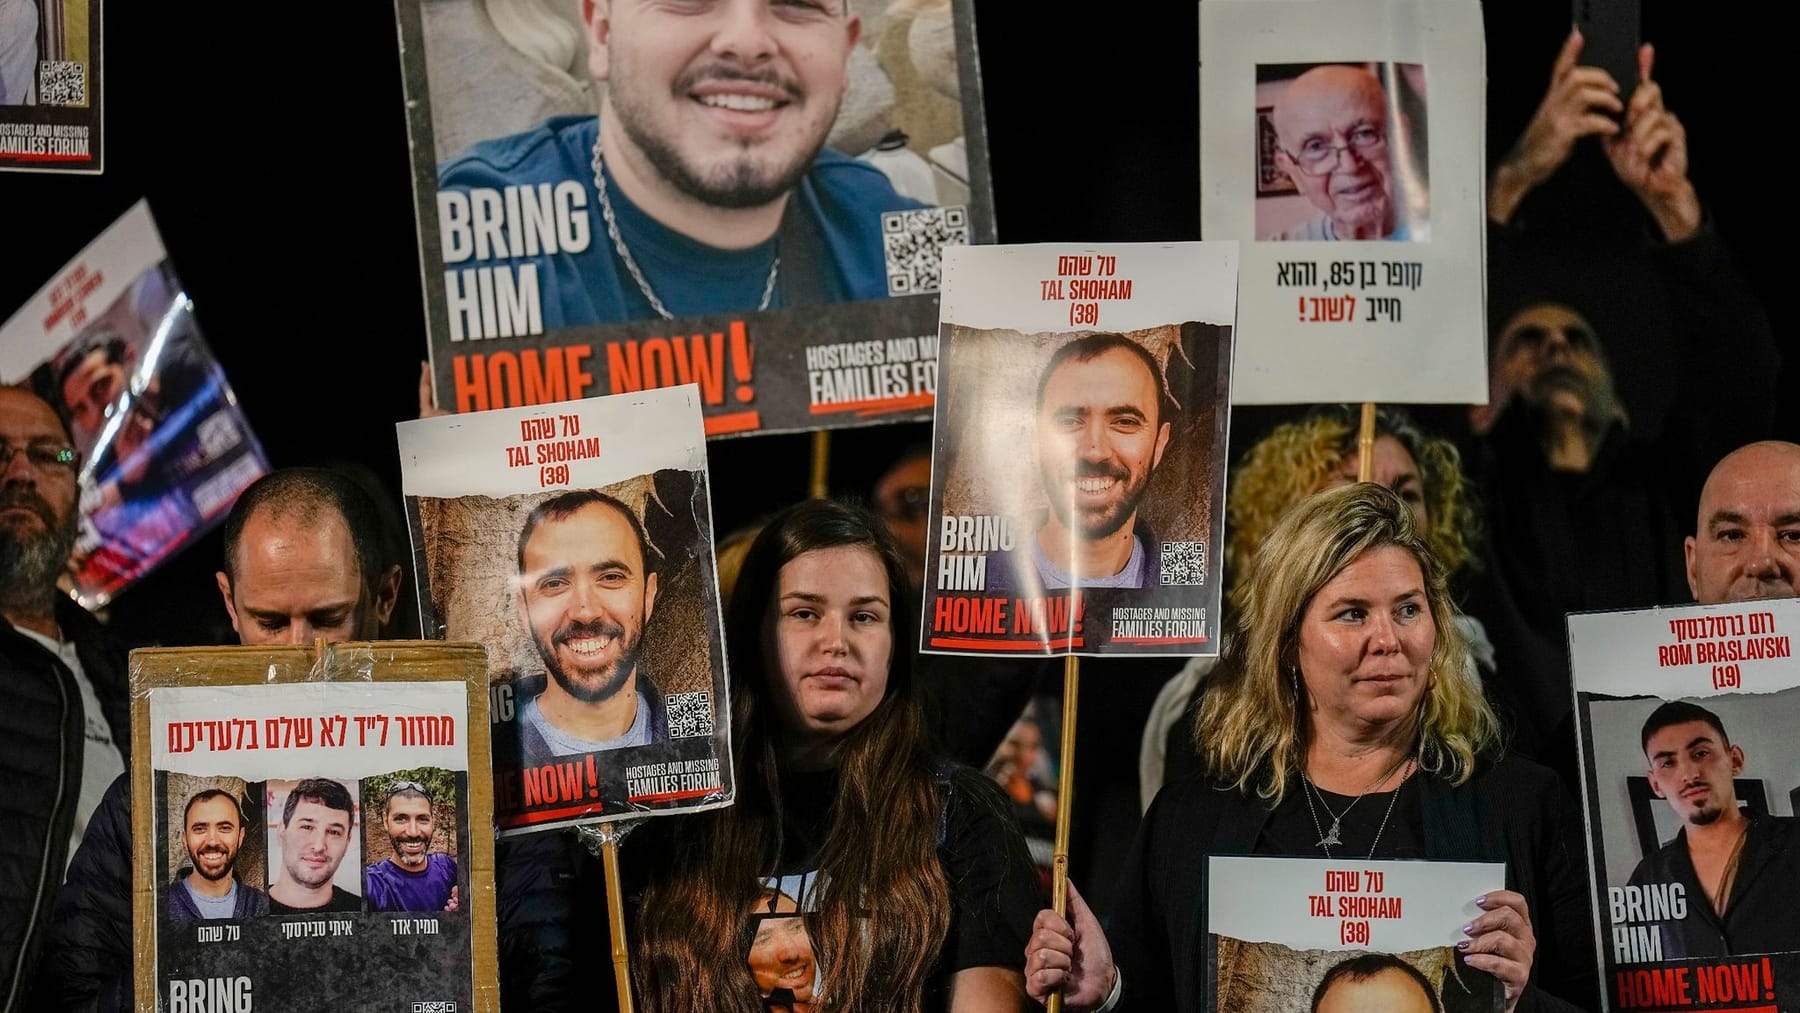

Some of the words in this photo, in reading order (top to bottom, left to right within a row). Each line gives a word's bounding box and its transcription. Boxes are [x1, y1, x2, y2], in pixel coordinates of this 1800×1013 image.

[0, 123, 34, 137] OSTAGES
[36, 124, 52, 137] AND
[53, 125, 89, 138] MISSING
[0, 136, 45, 155] AMILIES
[48, 138, 89, 156] FORUM
[436, 180, 591, 263] BRING
[1057, 255, 1093, 277] שהם
[1096, 254, 1116, 277] טל
[1277, 261, 1317, 287] והוא
[1359, 261, 1377, 291] בן
[1381, 261, 1423, 291] קופר
[444, 263, 543, 342] HIM
[1040, 279, 1065, 301] TAL
[1069, 279, 1132, 300] SHOHAM
[1069, 302, 1099, 326] (38)
[1298, 293, 1356, 323] לשוב!
[1365, 296, 1402, 323] חייב
[606, 320, 755, 405] NOW!
[806, 340, 884, 370] HOSTAGES
[886, 337, 918, 362] AND
[918, 335, 938, 361] MI
[809, 363, 909, 406] FAMILIES
[911, 360, 938, 396] FO
[520, 417, 557, 442] שהם
[558, 414, 580, 438] טל
[505, 445, 533, 468] TAL
[536, 437, 601, 465] SHOHAM
[539, 463, 570, 488] (38)
[940, 515, 1017, 552] BRING
[937, 555, 987, 591] HIM
[934, 596, 1008, 634] HOME
[1013, 590, 1086, 635] NOW!
[1112, 607, 1153, 620] HOSTAGES
[1153, 607, 1170, 620] AND
[1170, 607, 1206, 620] MISSING
[1747, 612, 1775, 635] רום
[1112, 620, 1163, 638] FAMILIES
[1166, 620, 1206, 638] FORUM
[1669, 614, 1746, 643] ברסלבסקי
[1658, 643, 1693, 667] ROM
[1696, 636, 1791, 664] BRASLAVSKI
[1712, 663, 1741, 690] (19)
[168, 717, 259, 753] בלעדיכם
[265, 716, 313, 749] שלם
[319, 714, 347, 748] לא
[394, 715, 455, 747] מחזור
[523, 754, 600, 807] NOW!
[625, 762, 667, 781] HOSTAGES
[667, 761, 684, 776] AND
[684, 758, 719, 774] MISSING
[627, 774, 678, 798] FAMILIES
[680, 770, 720, 792] FORUM
[1325, 870, 1360, 892] שהם
[1363, 869, 1384, 893] טל
[1308, 895, 1335, 917] TAL
[1338, 896, 1402, 918] SHOHAM
[1608, 882, 1688, 924] BRING
[197, 926, 223, 943] שהם
[225, 924, 241, 941] טל
[281, 921, 326, 940] סבירסקי
[328, 920, 353, 936] איתי
[390, 919, 411, 935] אדר
[413, 919, 439, 935] תמיר
[1340, 920, 1370, 946] (38)
[1613, 924, 1663, 965] HIM
[169, 975, 253, 1013] BRING
[1616, 967, 1692, 1009] HOME
[1696, 957, 1776, 1004] NOW!
